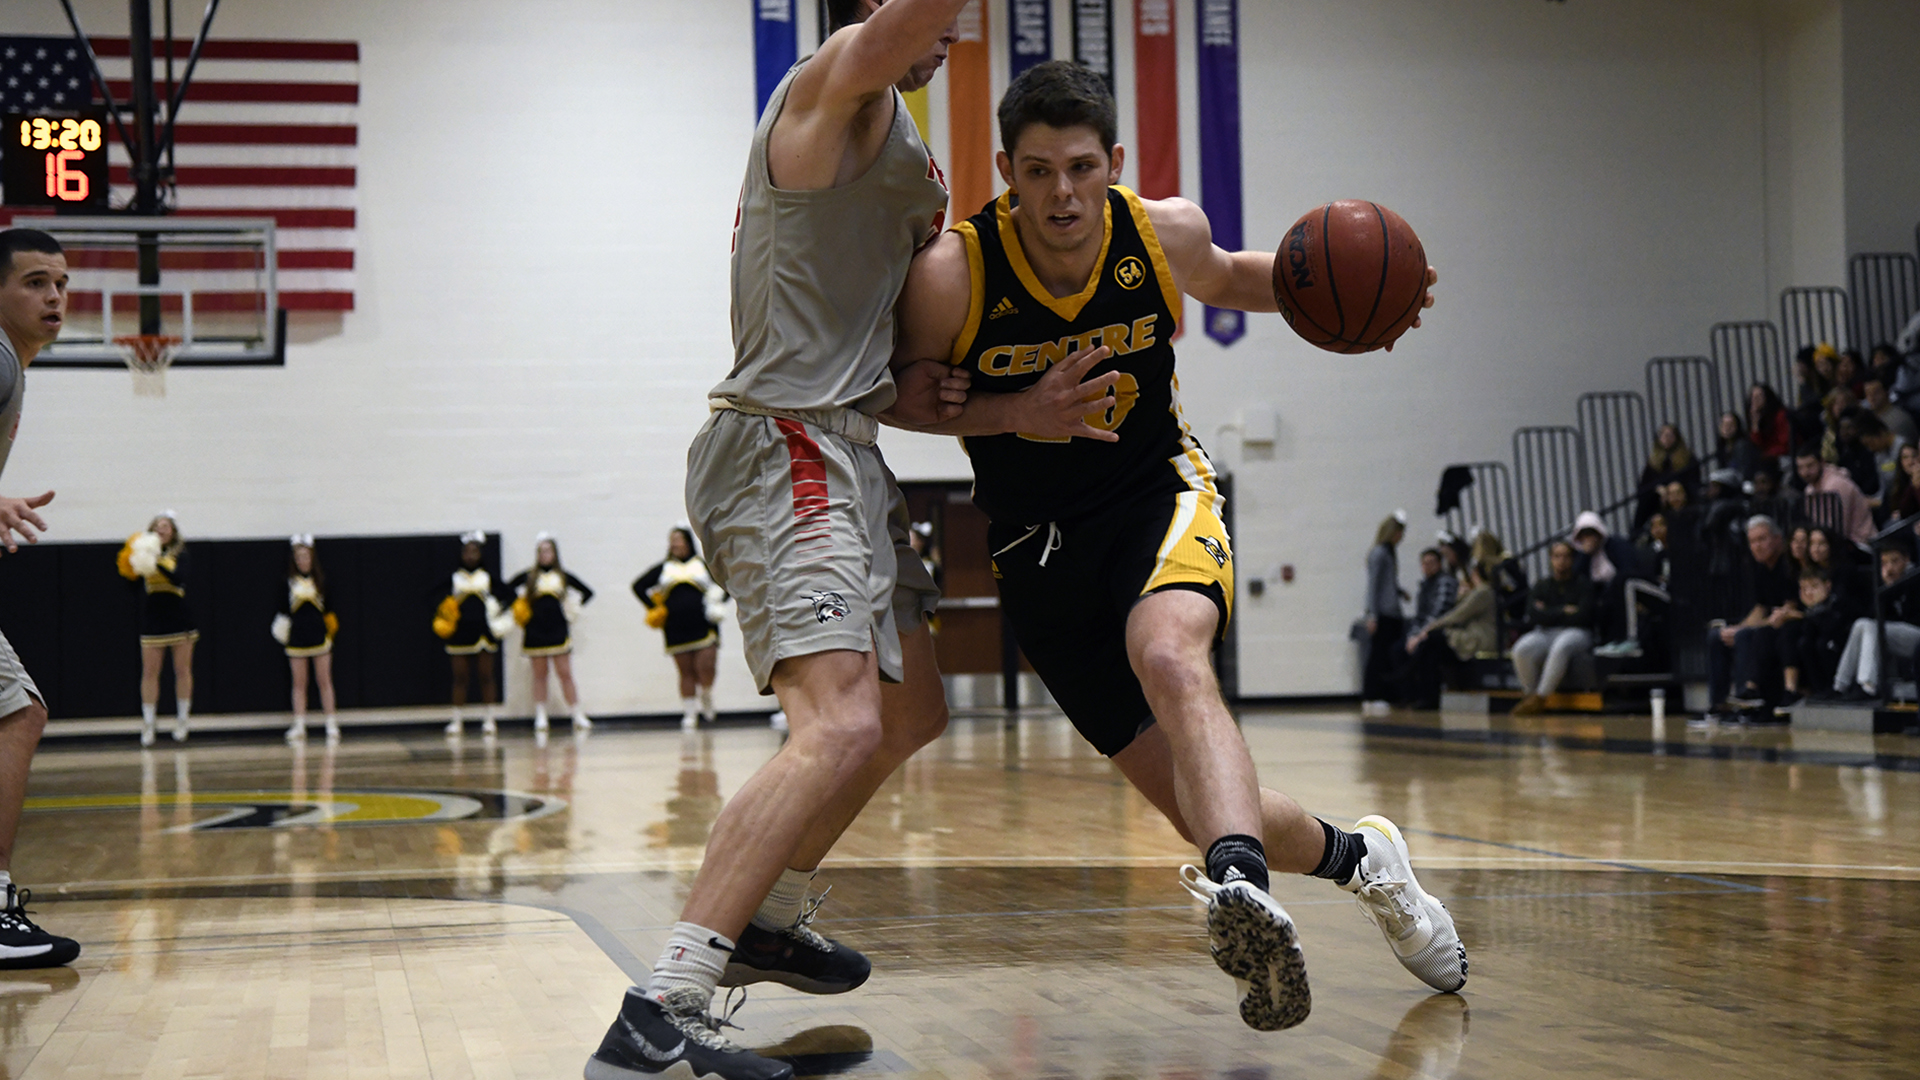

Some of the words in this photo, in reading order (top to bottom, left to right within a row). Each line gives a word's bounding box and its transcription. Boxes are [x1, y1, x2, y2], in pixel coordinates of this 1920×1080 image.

[20, 118, 101, 151] 13:20
[45, 150, 90, 201] 16
[1119, 261, 1142, 284] 54
[1289, 220, 1314, 290] NCAA
[978, 313, 1158, 376] CENTRE
